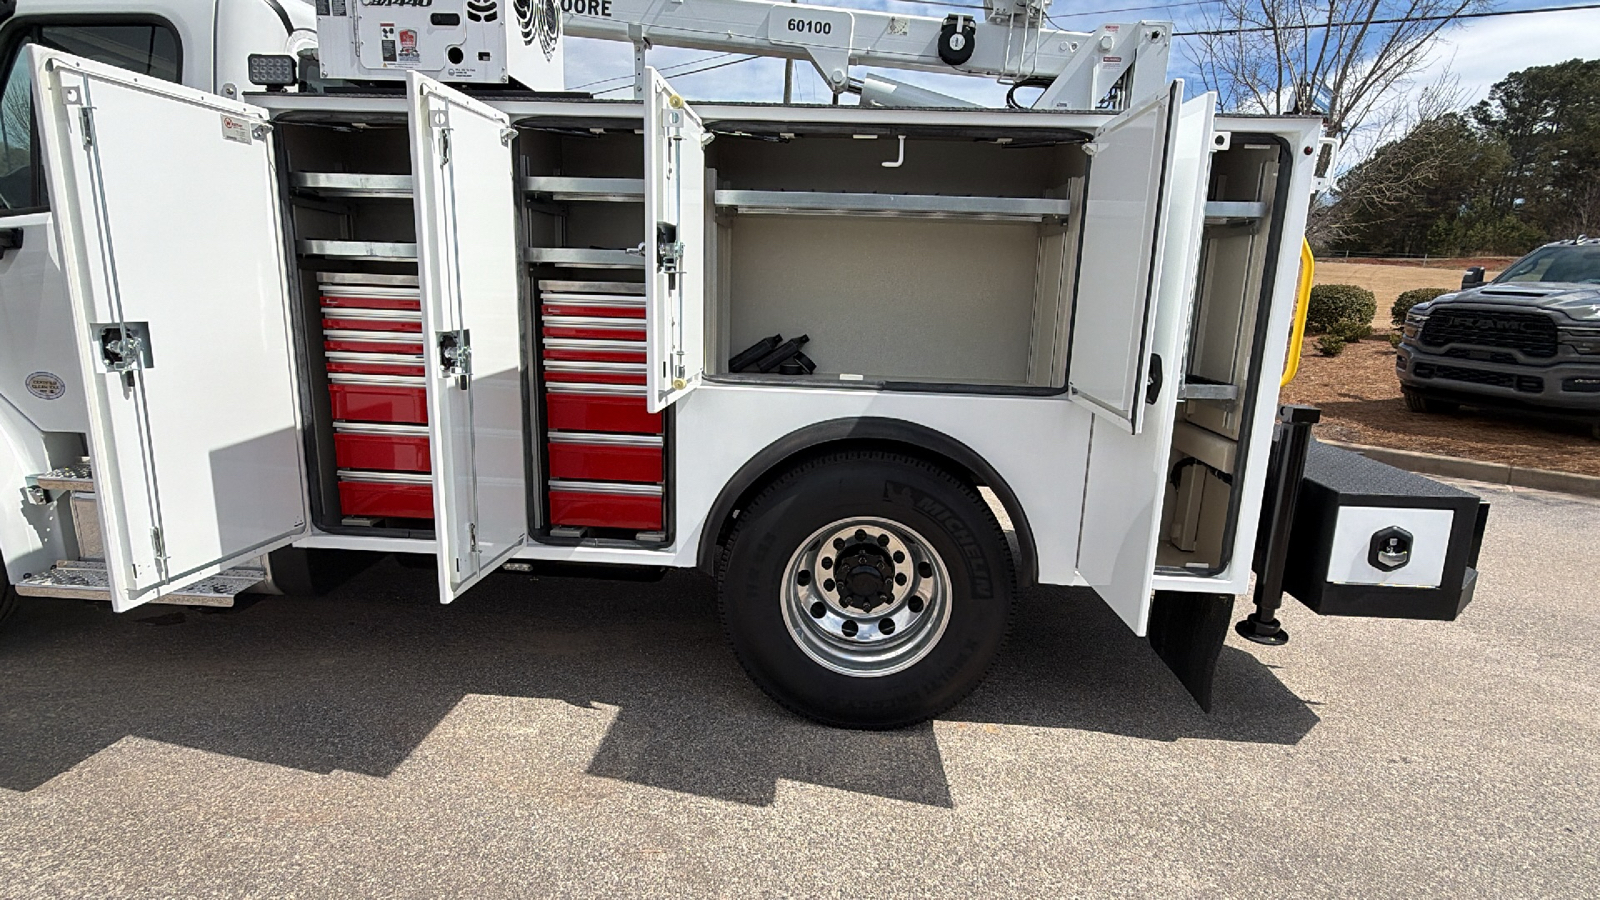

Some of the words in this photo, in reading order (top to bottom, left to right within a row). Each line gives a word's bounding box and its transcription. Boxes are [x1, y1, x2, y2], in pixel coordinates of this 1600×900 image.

[787, 18, 831, 35] 60100
[1452, 316, 1521, 331] RAM
[918, 495, 994, 599] MICHELIN
